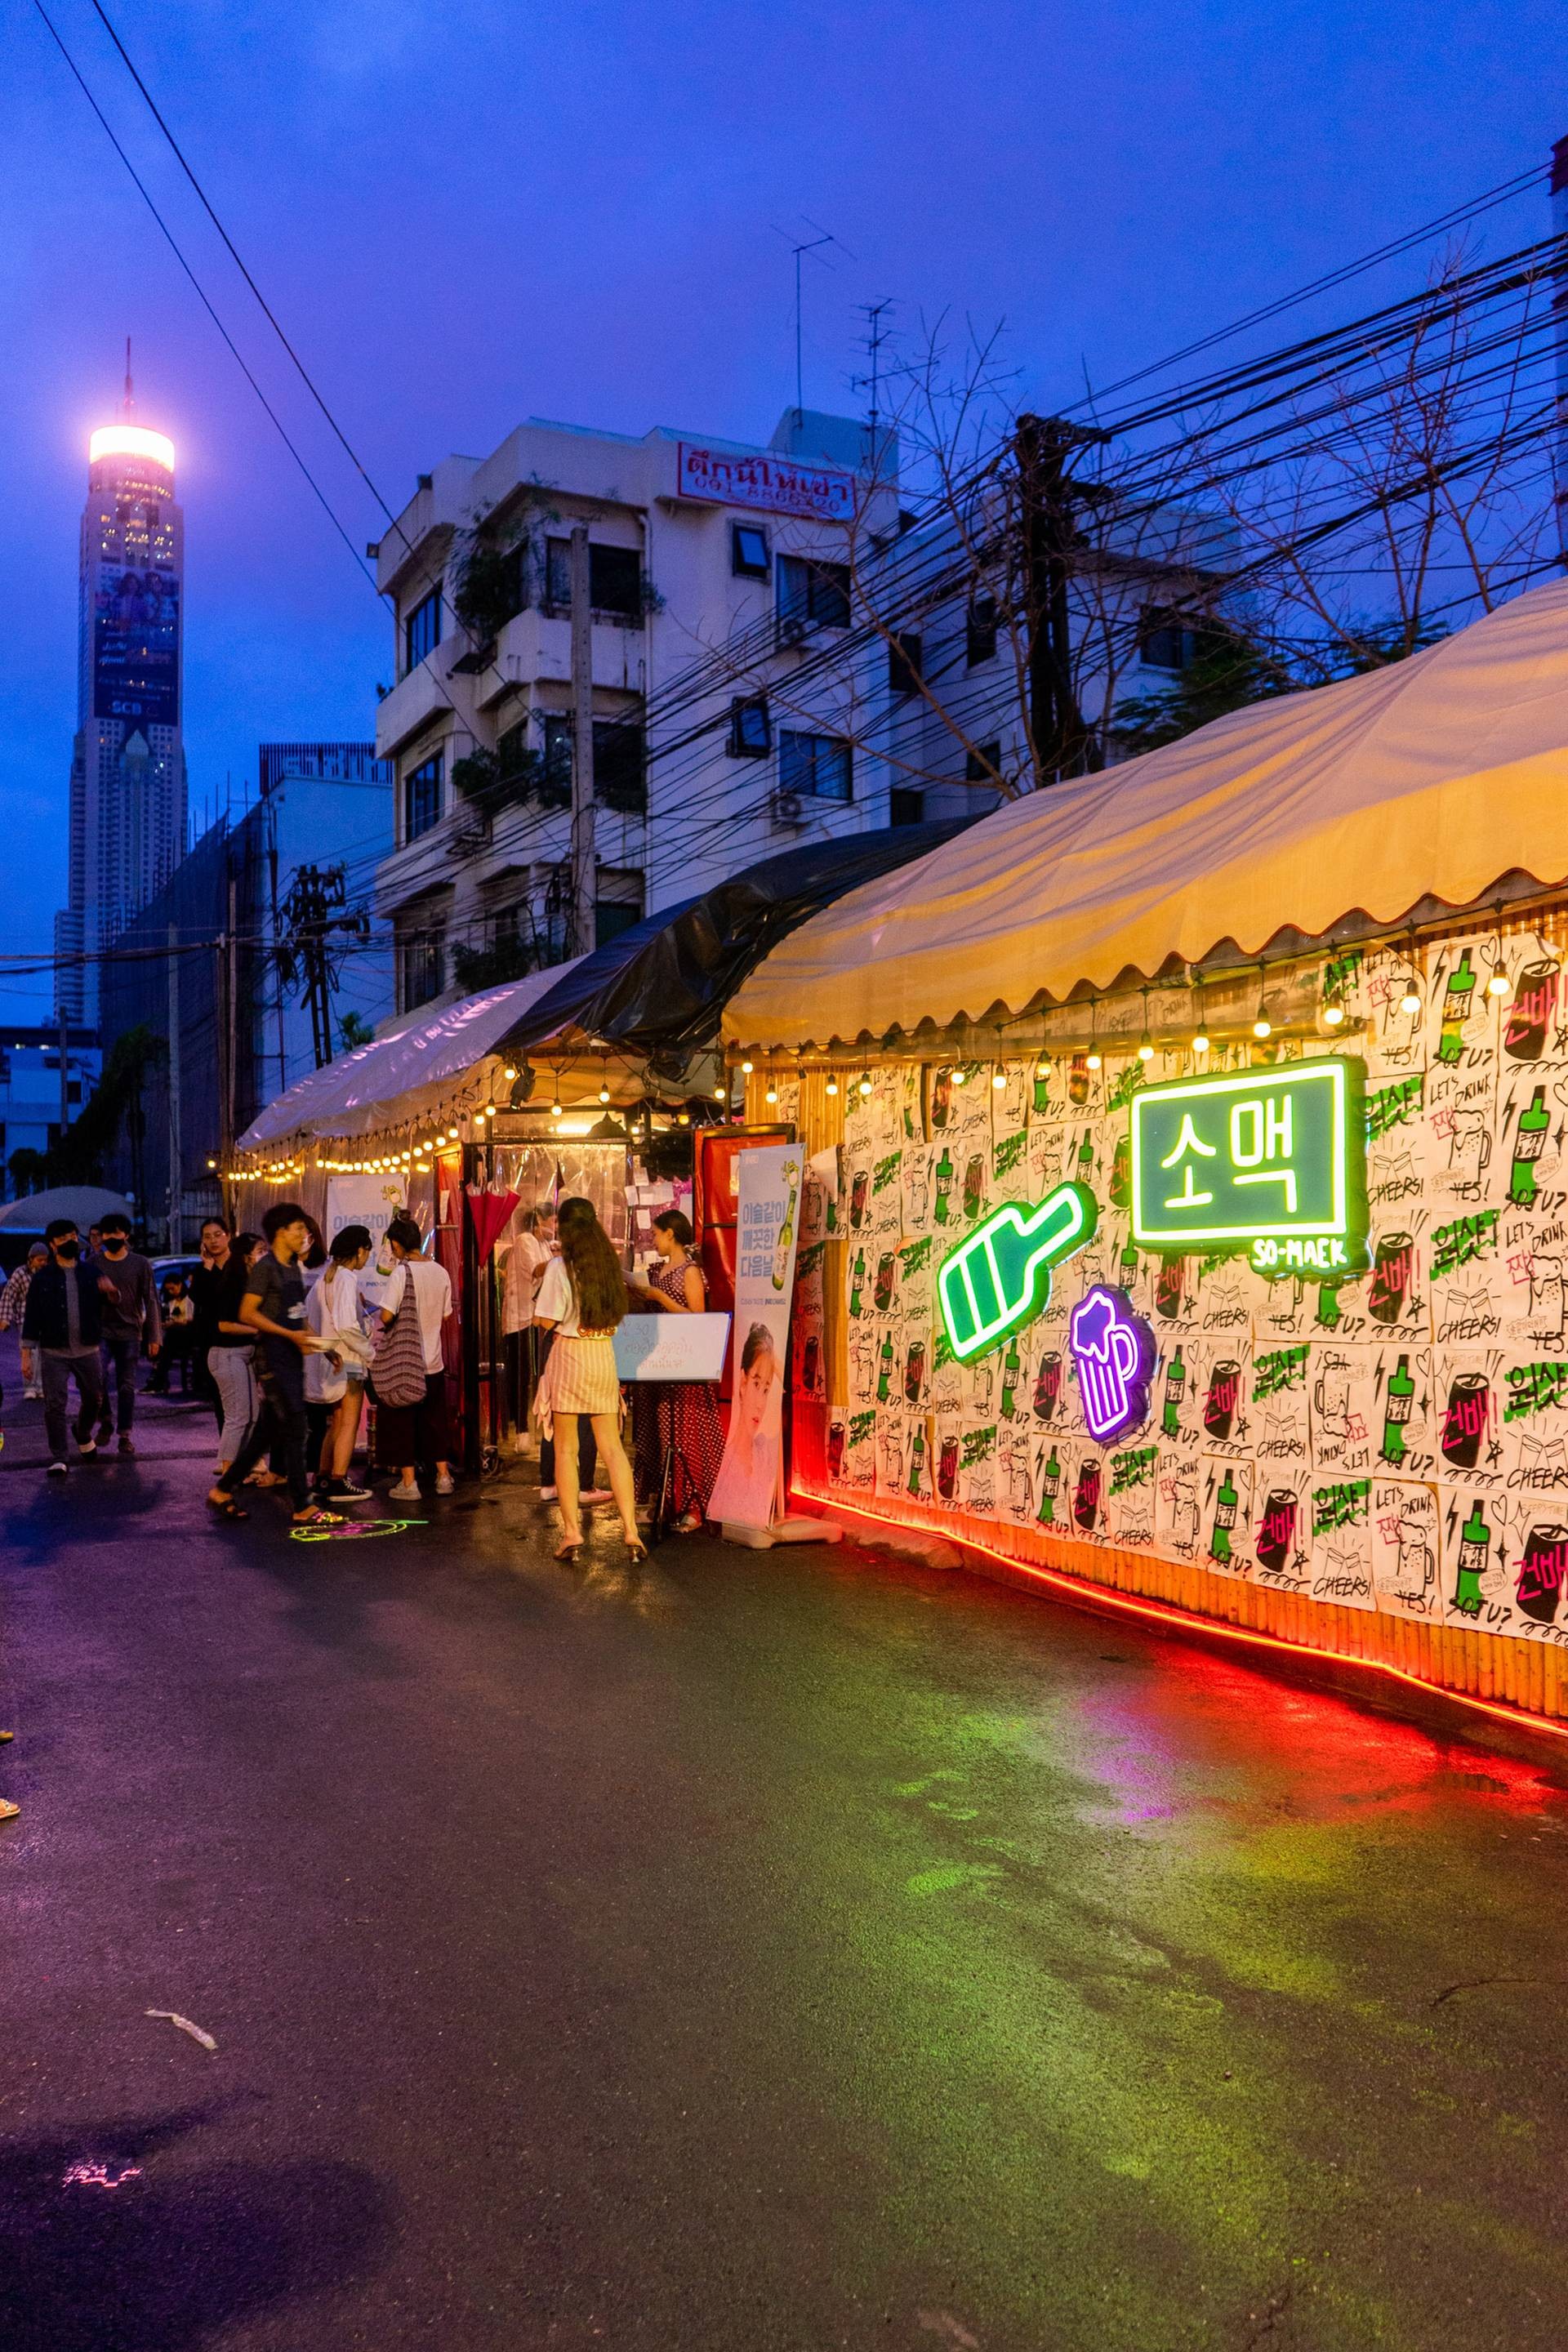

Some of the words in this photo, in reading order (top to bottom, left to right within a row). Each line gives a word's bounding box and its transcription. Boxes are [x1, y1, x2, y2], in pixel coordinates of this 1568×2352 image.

[1381, 1042, 1419, 1066] YES!
[1160, 1094, 1298, 1214] 소맥
[1367, 1177, 1424, 1206] CHEERS!
[1449, 1178, 1491, 1202] YES!
[742, 1200, 786, 1225] 이슬같이
[740, 1254, 775, 1278] 다음날
[1203, 1307, 1249, 1330] CHEERS!
[1268, 1313, 1304, 1334] YES!
[1437, 1315, 1501, 1343] CHEERS!
[1257, 1438, 1307, 1459] CHEERS!
[1114, 1530, 1155, 1548] CHEERS!
[1313, 1576, 1370, 1599] CHEERS!
[1393, 1589, 1435, 1615] YES!
